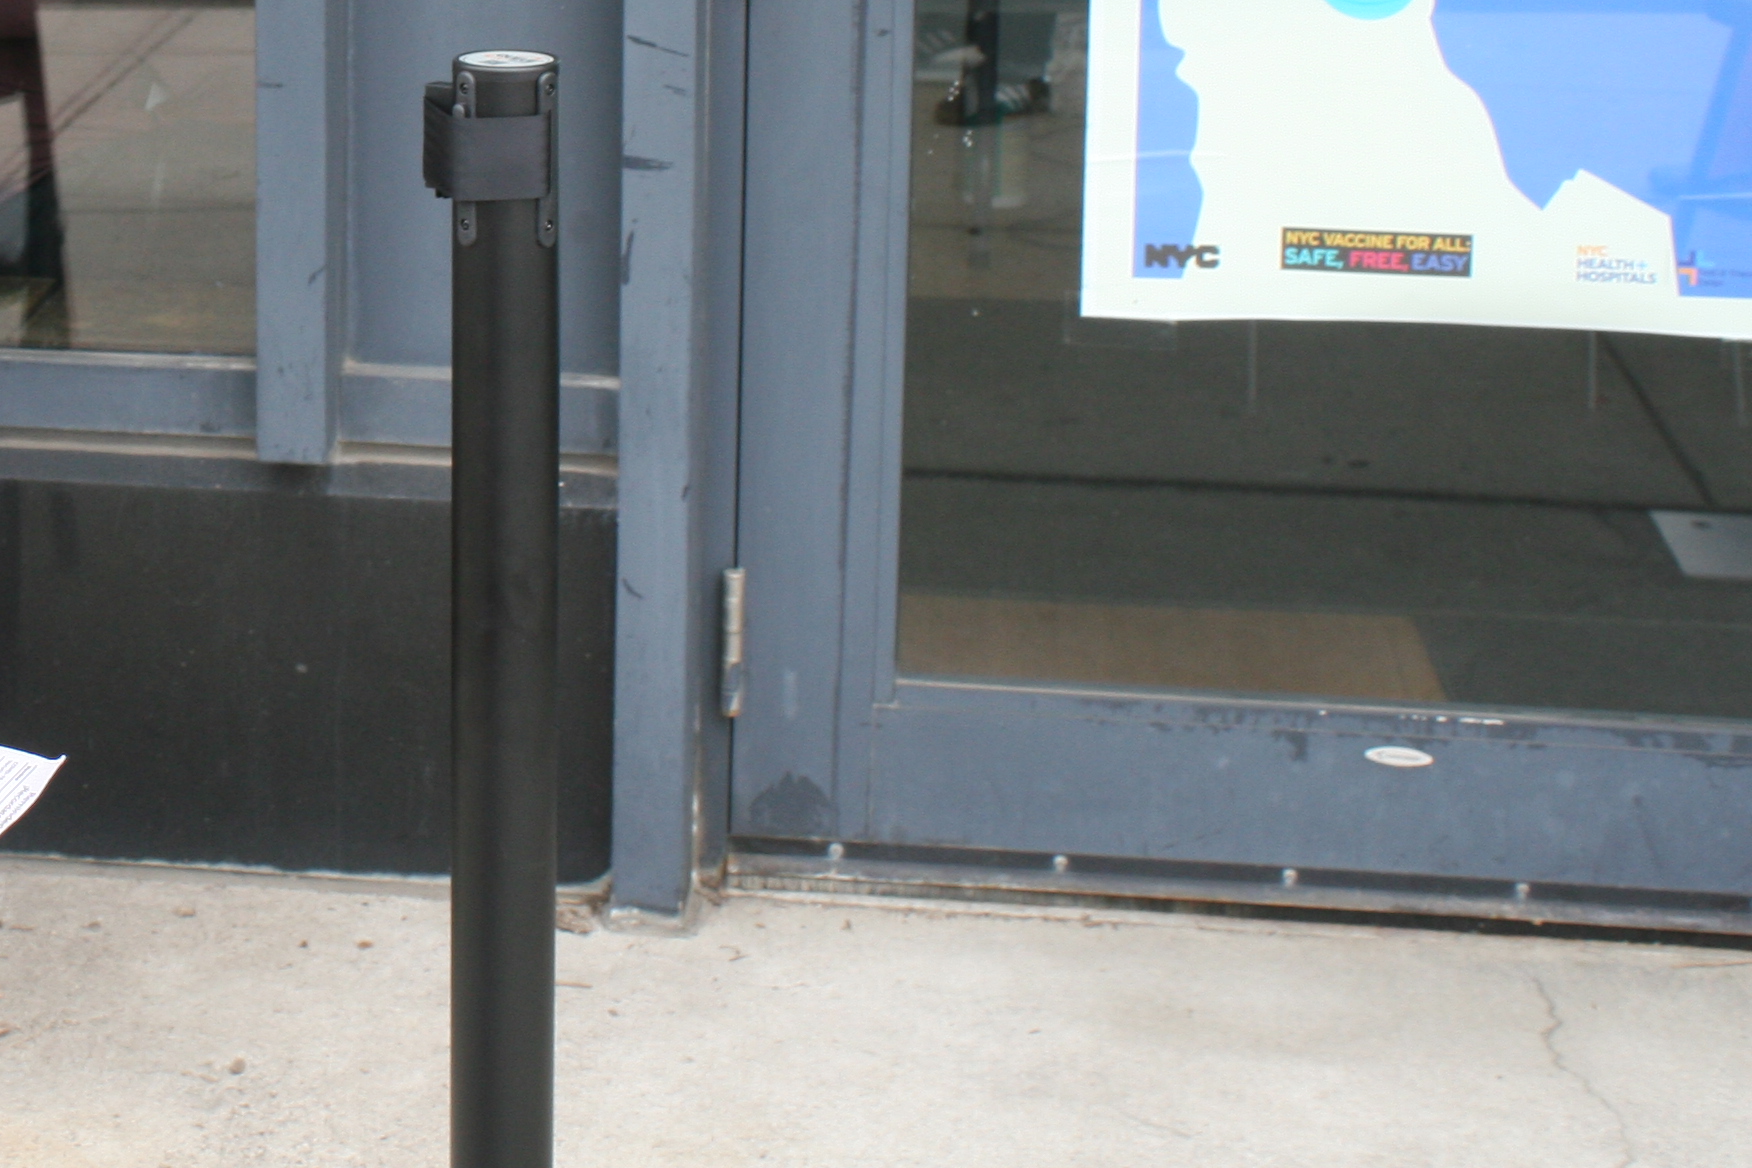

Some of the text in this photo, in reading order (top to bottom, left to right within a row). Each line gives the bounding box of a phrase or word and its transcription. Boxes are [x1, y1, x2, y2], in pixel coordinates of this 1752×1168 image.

[1285, 230, 1320, 246] NYC
[1324, 232, 1394, 249] VACCINE
[1397, 235, 1431, 250] FOR
[1145, 243, 1220, 269] NYC
[1284, 247, 1469, 272] SAFE, FREE, EASY
[1576, 244, 1608, 257] NYC
[1576, 272, 1657, 284] HOSPITALS
